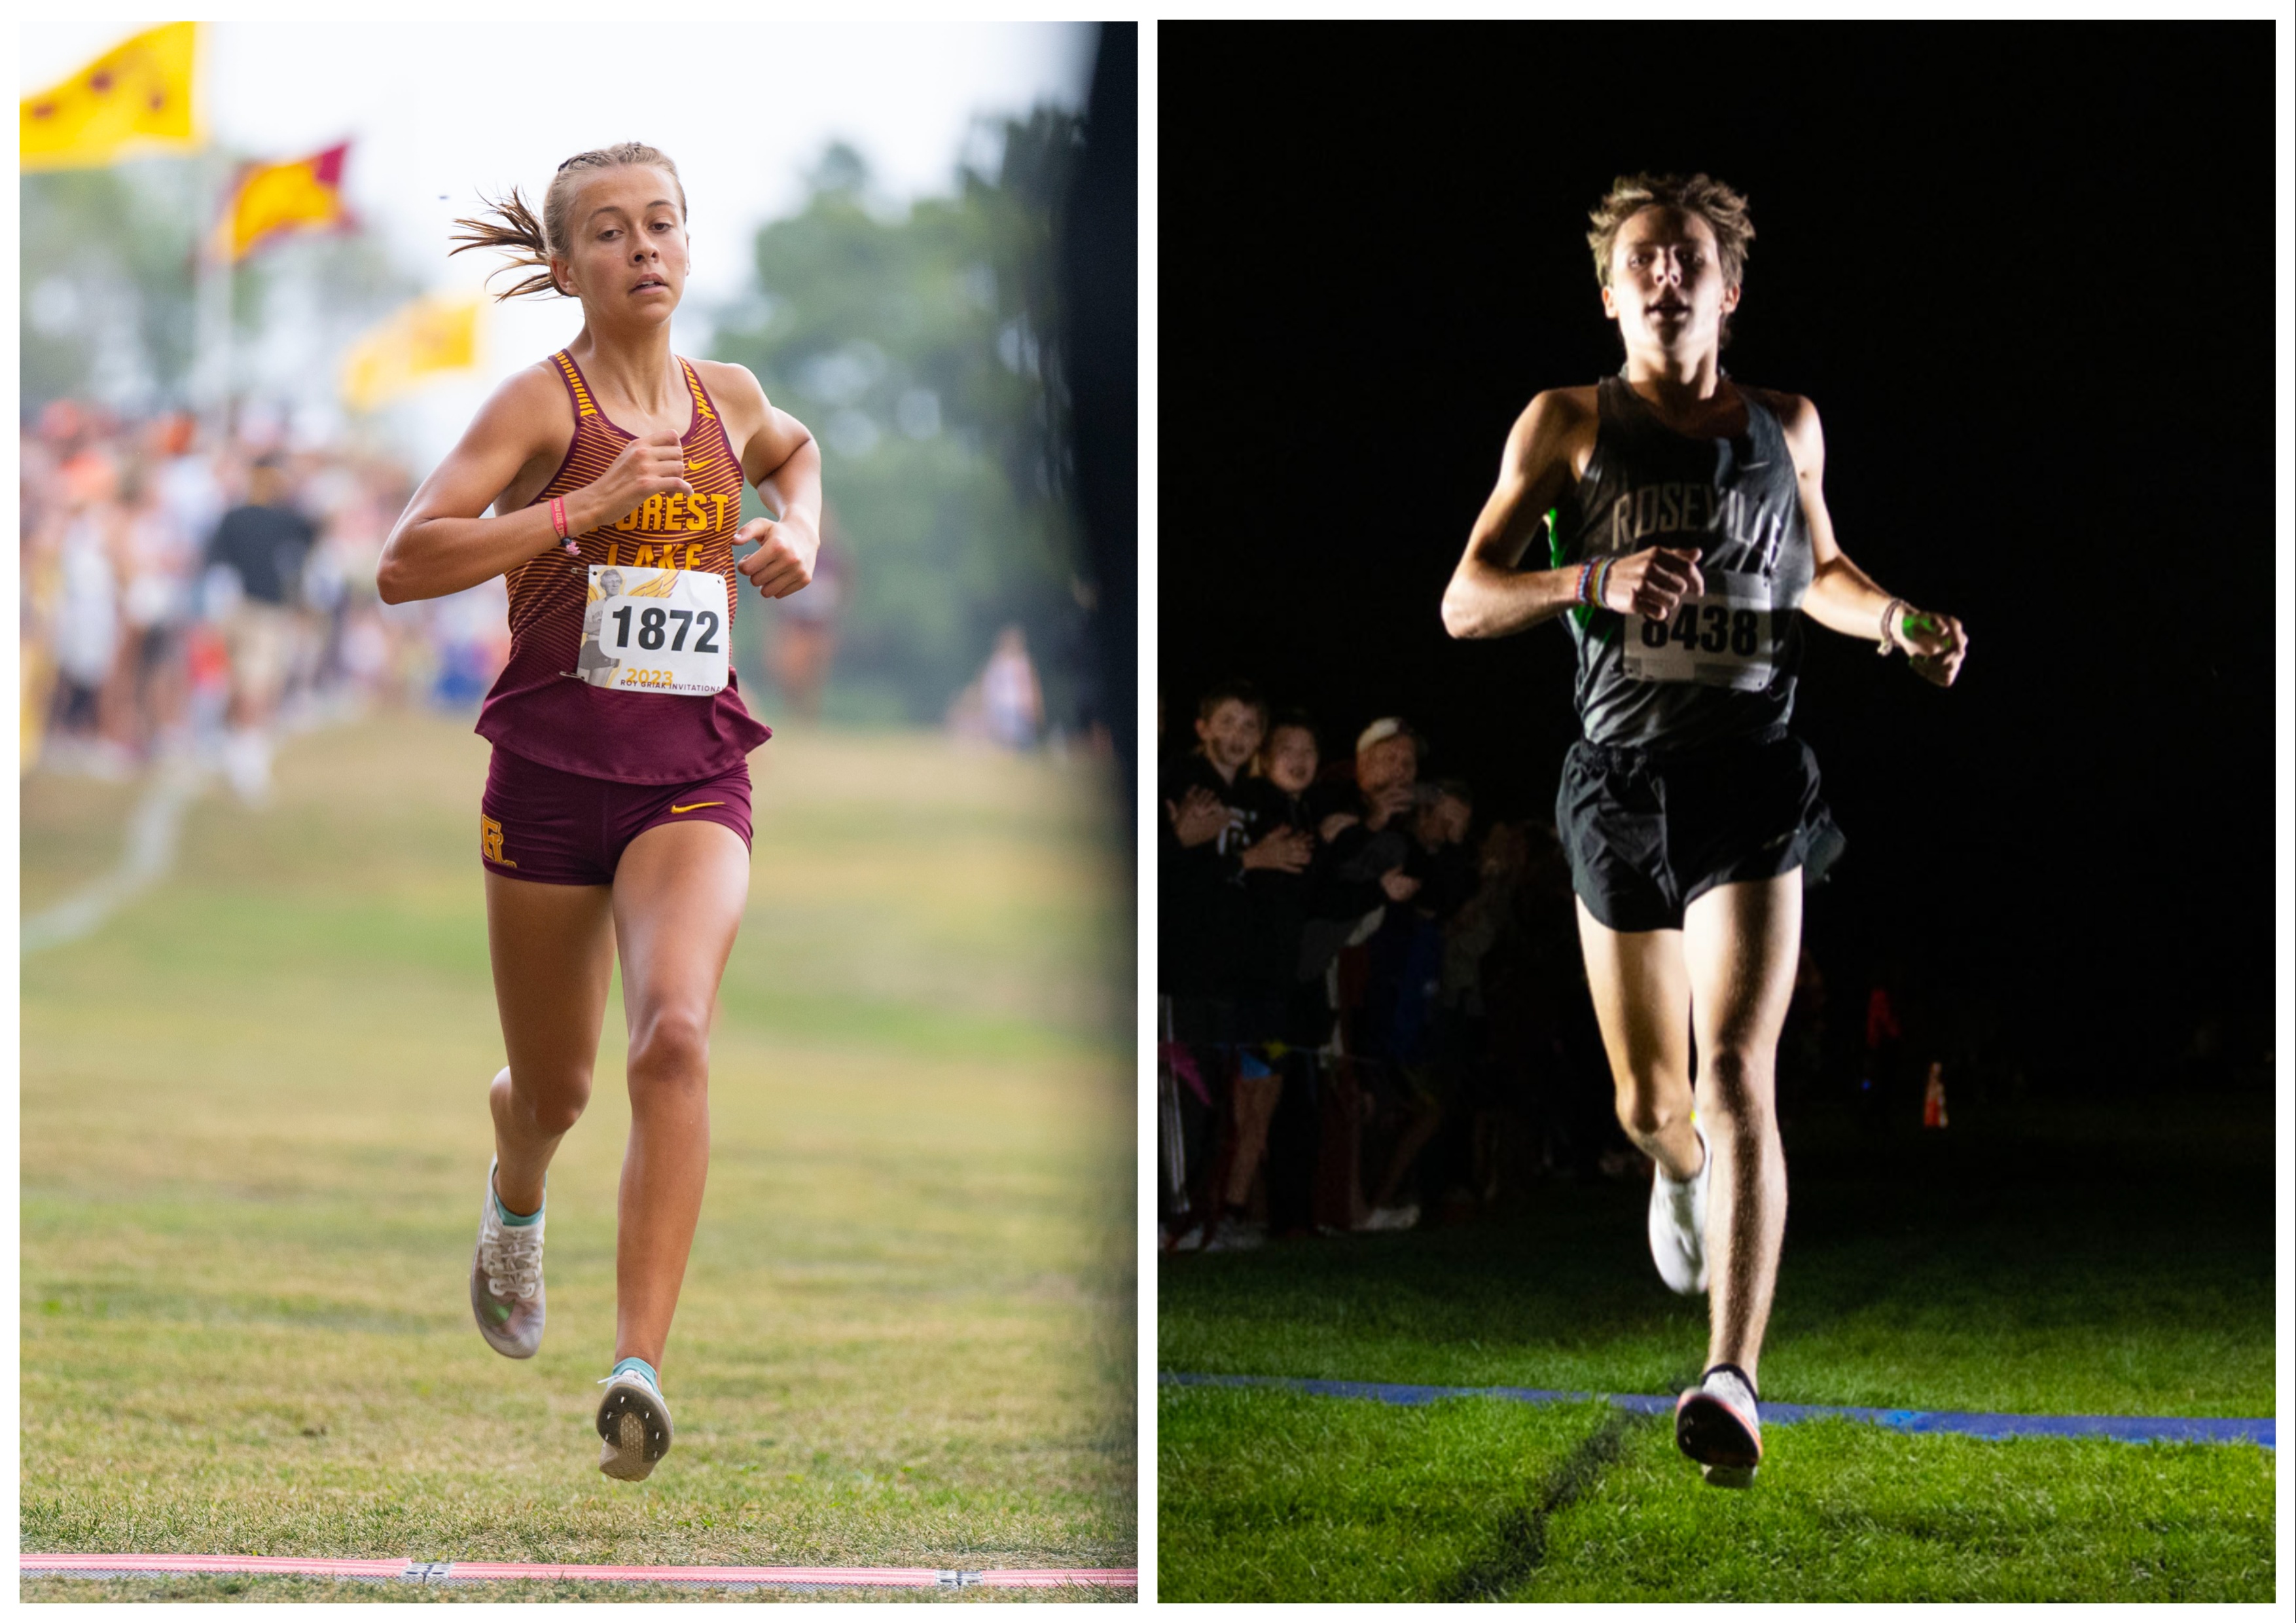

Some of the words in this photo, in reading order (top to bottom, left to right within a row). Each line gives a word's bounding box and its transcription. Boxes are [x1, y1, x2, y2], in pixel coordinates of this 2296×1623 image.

[555, 512, 564, 524] 2022
[588, 492, 728, 532] OREST
[613, 606, 719, 653] 1872
[1641, 603, 1757, 657] 8438
[626, 668, 673, 687] 2023
[641, 681, 667, 689] GRIAK
[669, 684, 725, 693] INVITATIONA
